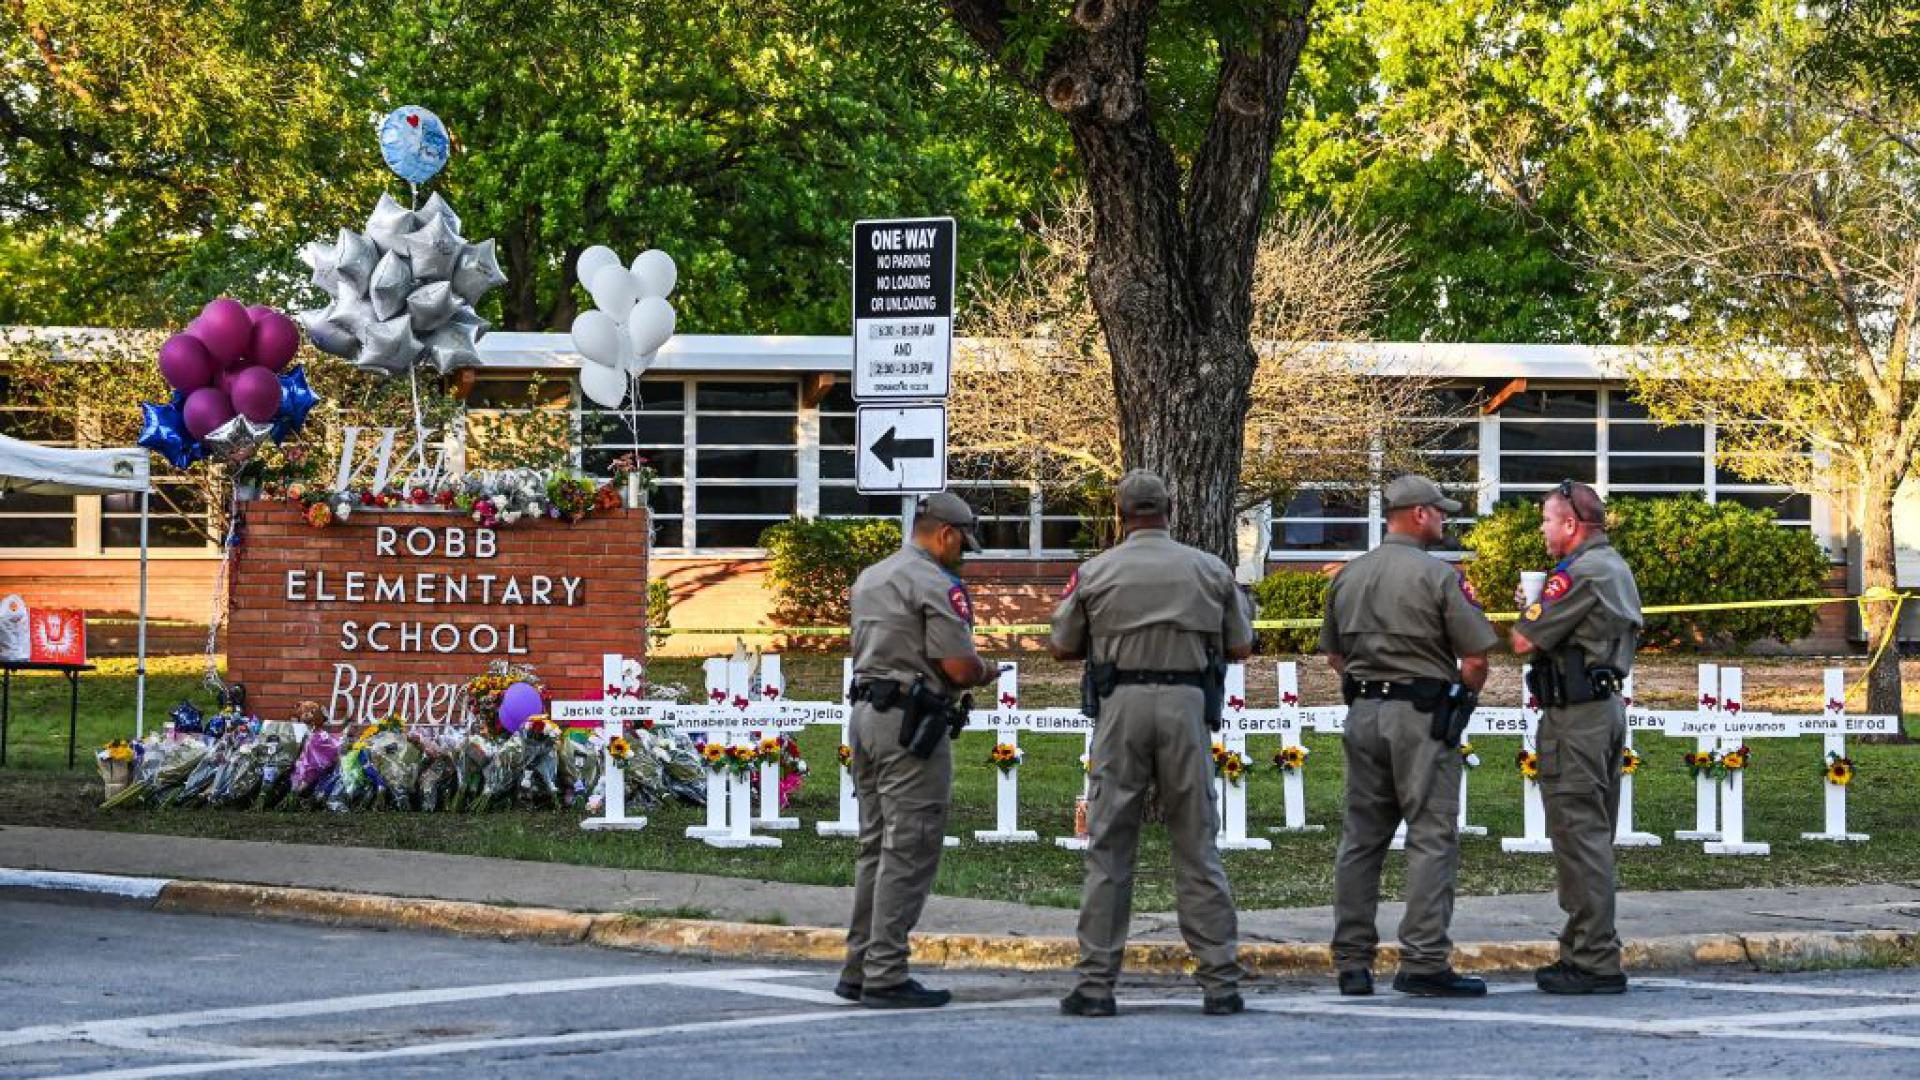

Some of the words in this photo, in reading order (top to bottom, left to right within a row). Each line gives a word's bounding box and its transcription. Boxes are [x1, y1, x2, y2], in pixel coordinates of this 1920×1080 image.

[871, 229, 902, 251] ONE
[905, 228, 938, 250] WAY
[877, 254, 891, 269] NO
[892, 253, 931, 269] PARKING
[877, 275, 891, 291] NO
[892, 275, 931, 290] LOADING
[871, 297, 884, 312] OR
[885, 296, 937, 311] UNLOADING
[922, 322, 936, 337] AM
[894, 342, 912, 357] AND
[920, 361, 934, 375] PM
[376, 526, 498, 558] ROBB
[286, 569, 583, 606] ELEMENTARY
[340, 621, 529, 655] SCHOOL
[329, 662, 470, 727] Bienven
[562, 706, 604, 717] Jackie
[610, 706, 652, 717] Cazar
[676, 716, 739, 728] Annabelle
[742, 716, 805, 729] Rodriguez
[1005, 714, 1021, 726] Jo
[1239, 718, 1291, 730] Garcia
[1485, 717, 1529, 731] Tess
[1628, 715, 1666, 727] Brav
[1681, 722, 1717, 733] Jayce
[1724, 722, 1786, 733] Luevanos
[1846, 718, 1886, 730] Elrod
